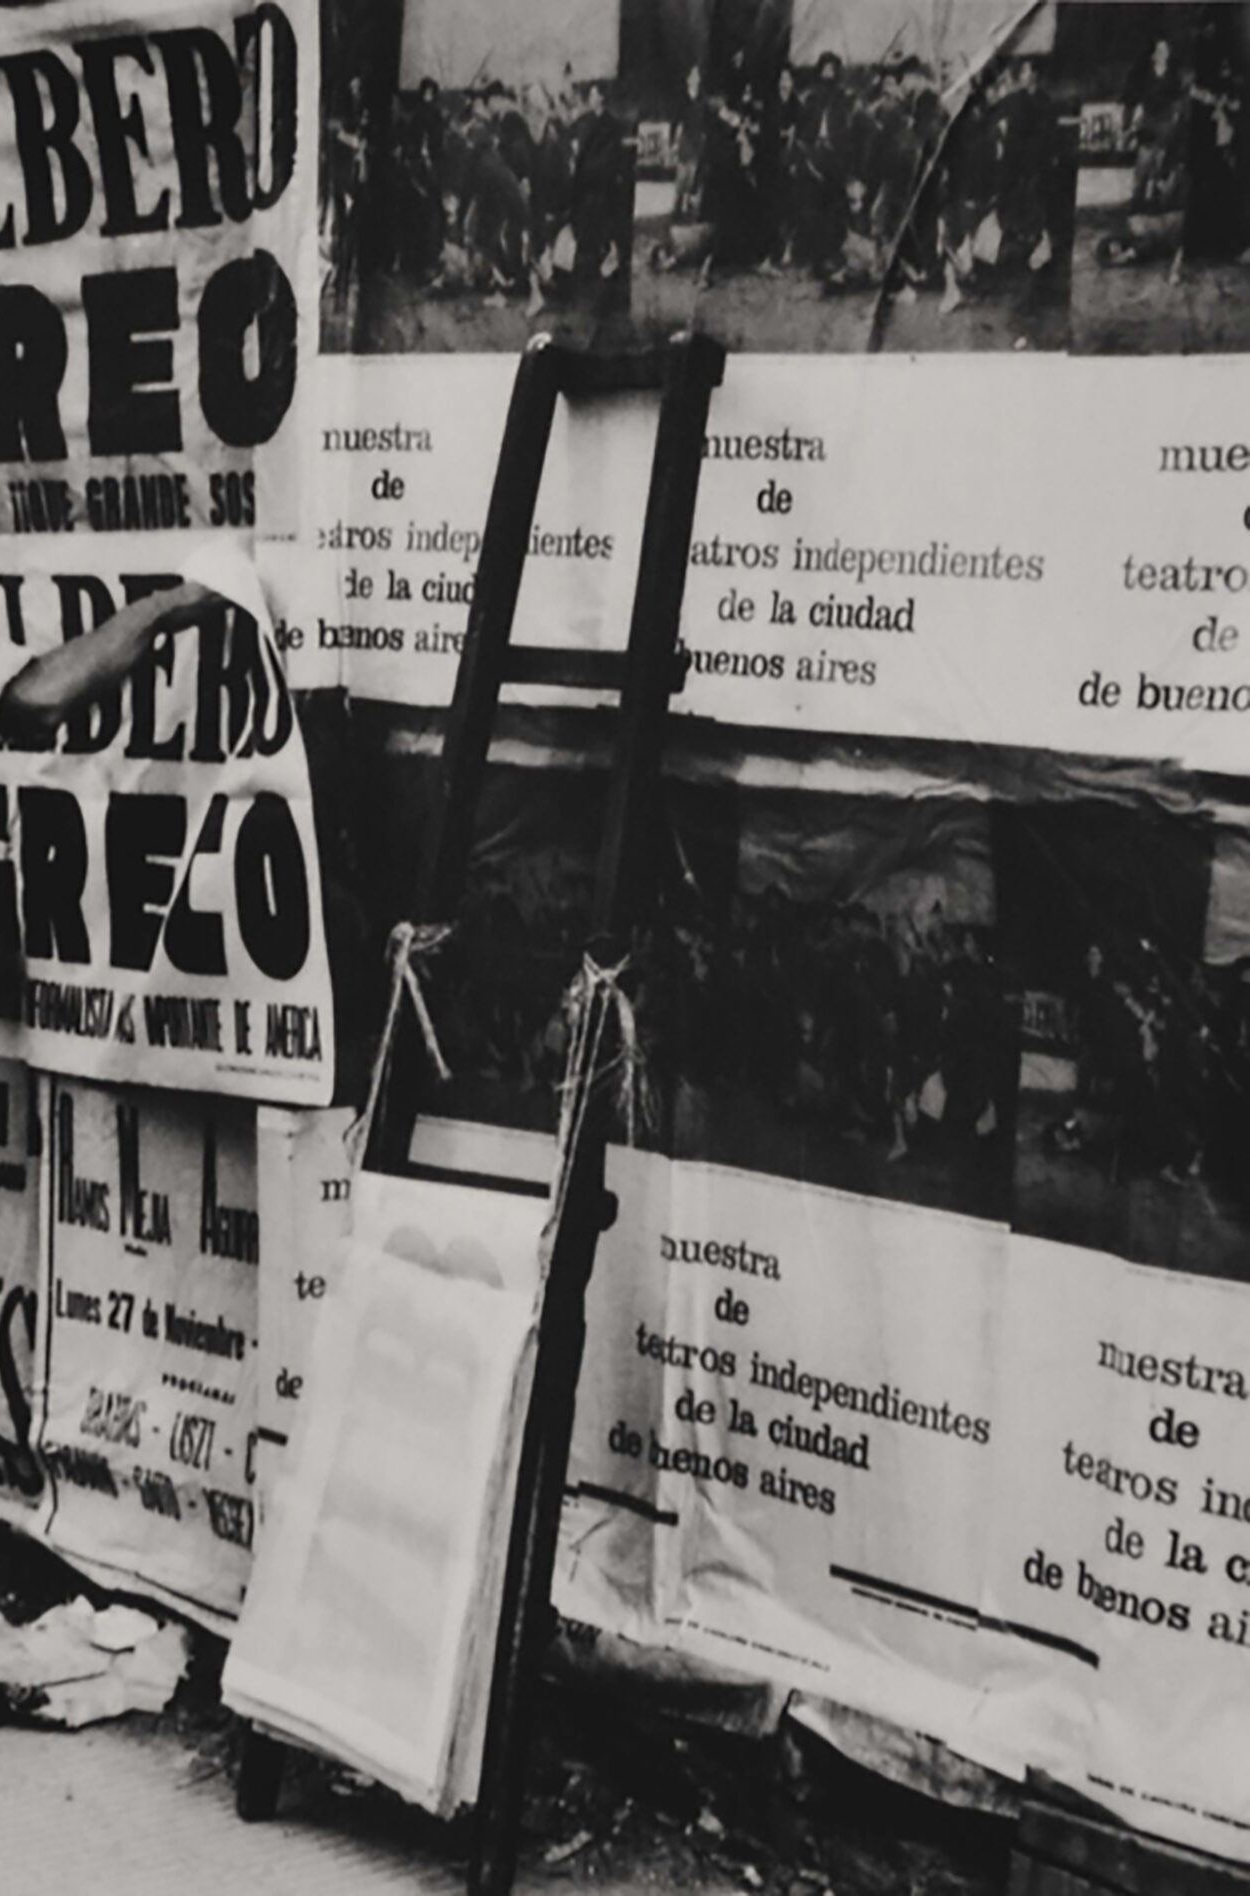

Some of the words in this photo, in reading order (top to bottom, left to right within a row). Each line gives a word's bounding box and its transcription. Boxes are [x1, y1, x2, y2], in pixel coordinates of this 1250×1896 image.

[371, 470, 405, 500] de
[756, 480, 793, 514] de
[792, 536, 1045, 584] independientes
[386, 569, 412, 601] la
[717, 589, 754, 623] de
[769, 590, 797, 625] la
[808, 595, 915, 633] ciudad
[1191, 615, 1240, 653] de
[795, 648, 877, 686] aires
[1077, 670, 1122, 708] de
[234, 999, 253, 1056] DE
[107, 1289, 135, 1334] 27
[713, 1287, 750, 1327] de
[749, 1350, 993, 1445] independientes
[675, 1387, 717, 1425] de
[727, 1397, 759, 1438] la
[768, 1414, 871, 1471] ciudad
[1149, 1406, 1201, 1450] de
[608, 1419, 643, 1459] de
[759, 1466, 837, 1516] aires
[1105, 1515, 1145, 1560] de
[1164, 1527, 1208, 1575] la
[1023, 1546, 1064, 1592] de
